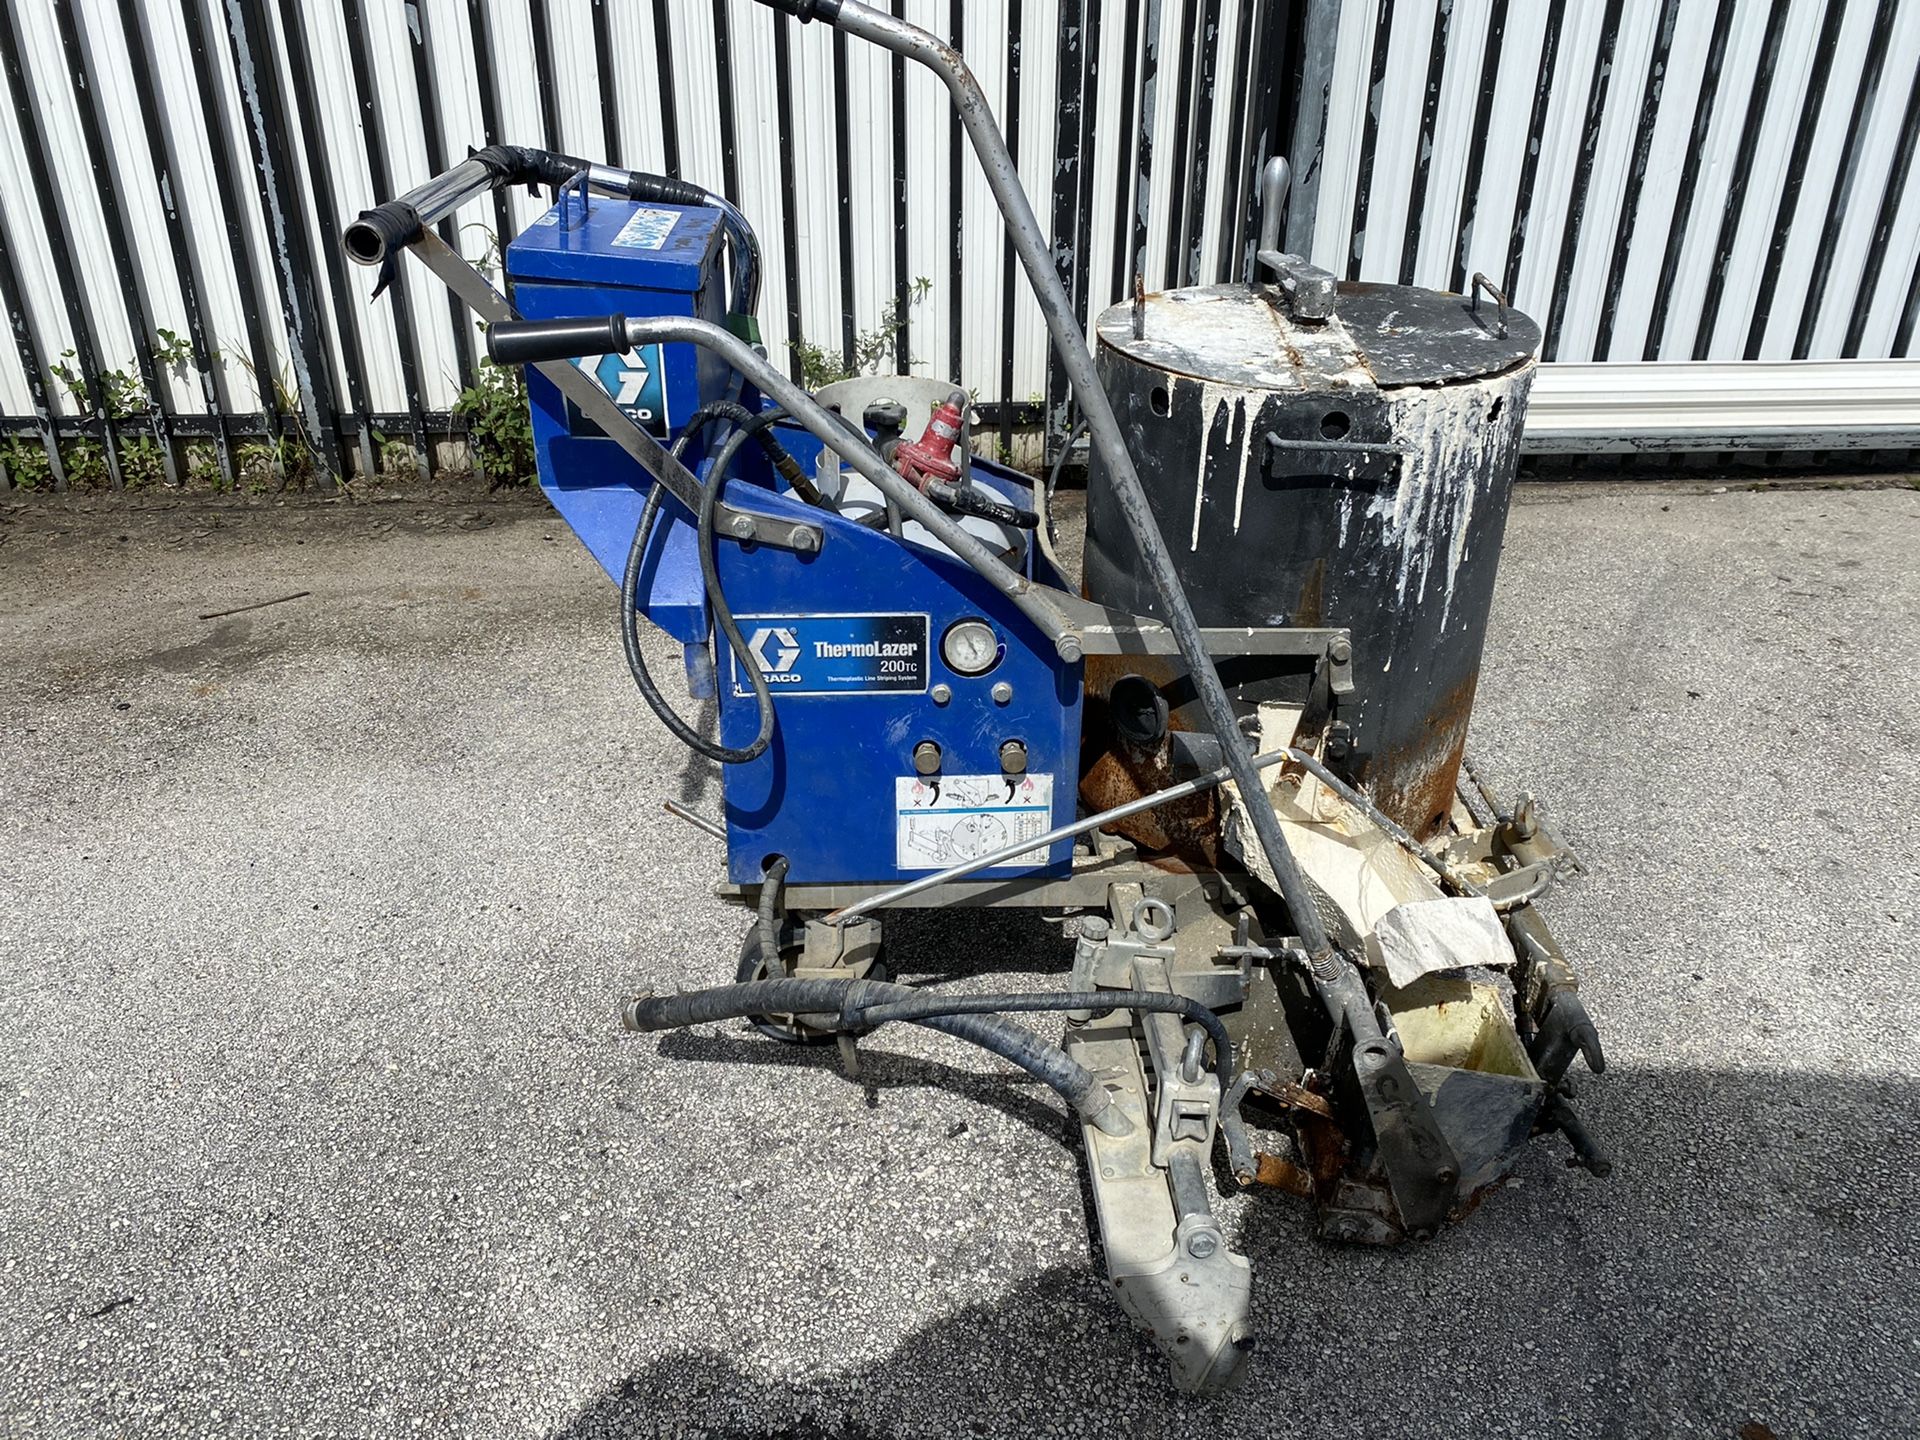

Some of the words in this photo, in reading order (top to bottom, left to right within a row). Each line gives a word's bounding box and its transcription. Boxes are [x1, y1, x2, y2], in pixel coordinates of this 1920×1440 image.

[813, 641, 918, 657] ThermoLazer
[880, 660, 918, 673] 200TC
[747, 673, 802, 683] RACO
[827, 675, 864, 683] Thermoplastic
